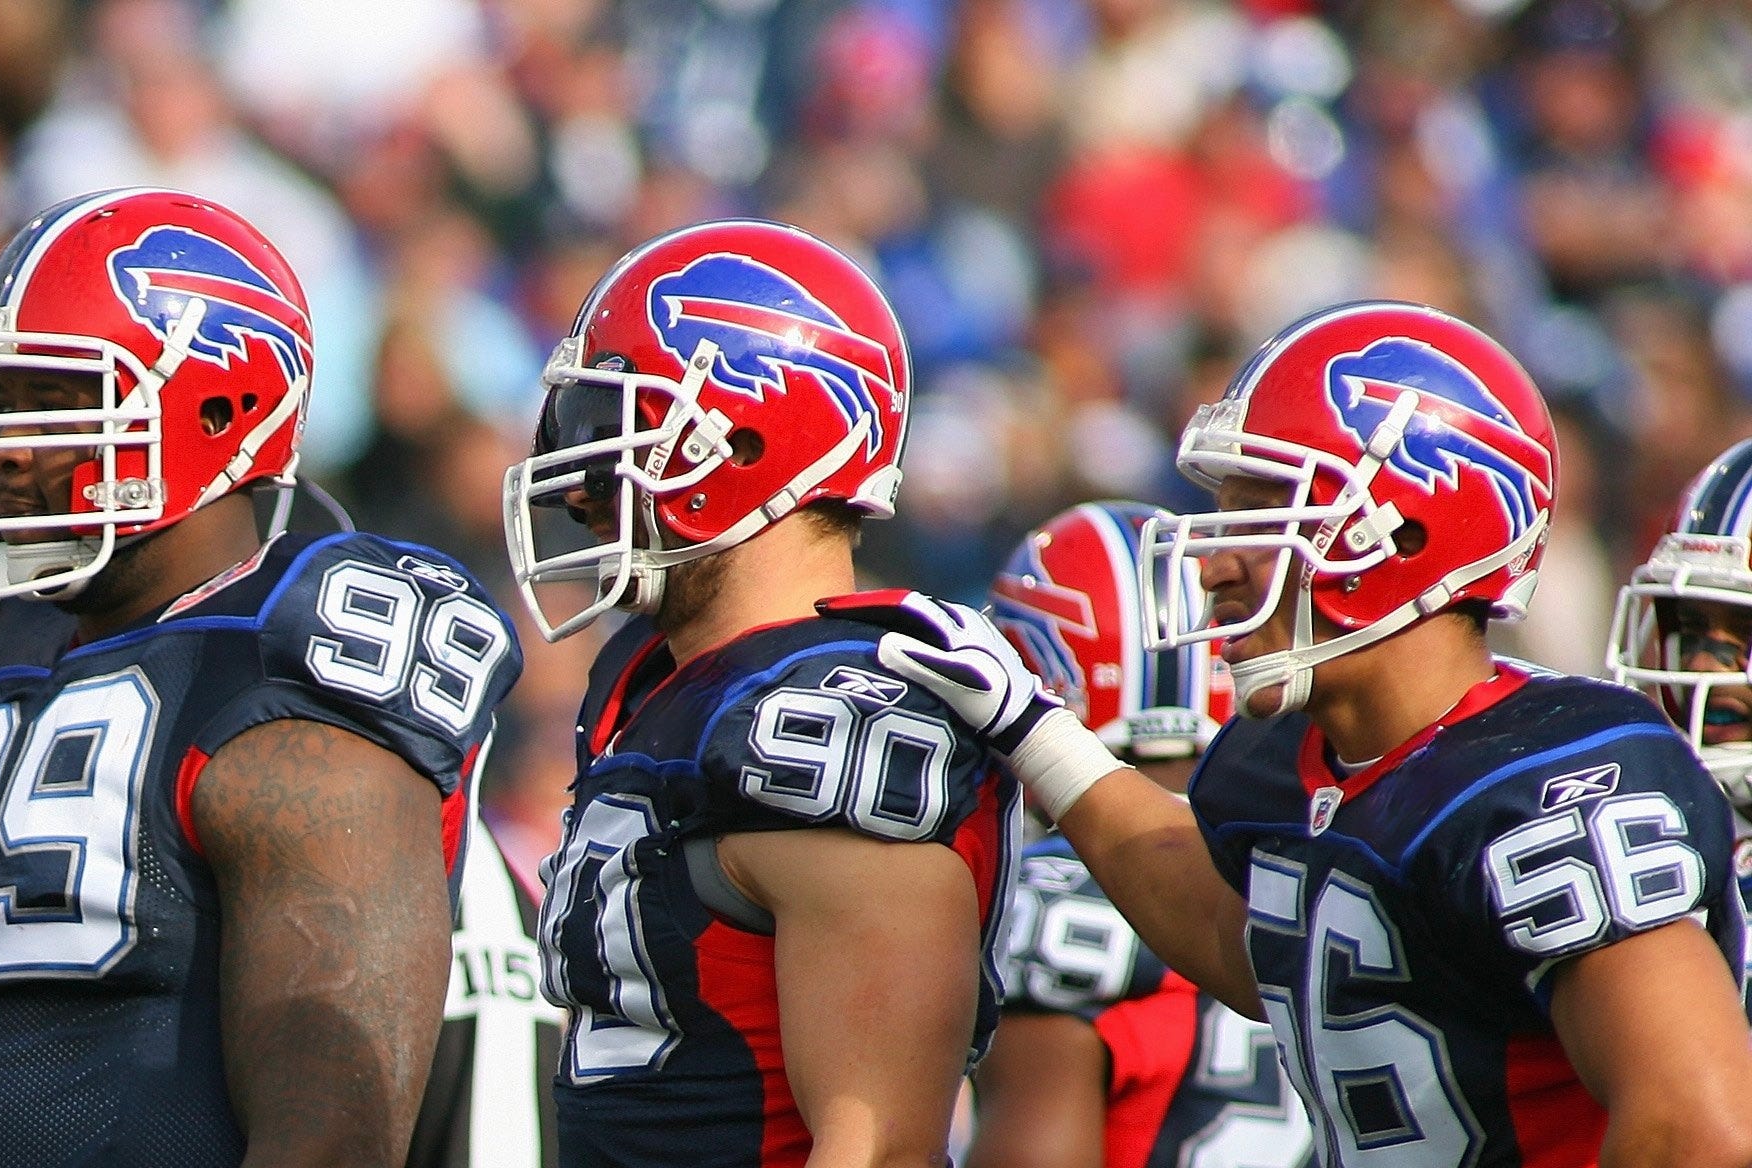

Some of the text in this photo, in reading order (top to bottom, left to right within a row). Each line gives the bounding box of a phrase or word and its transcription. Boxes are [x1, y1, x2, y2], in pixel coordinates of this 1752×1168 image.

[306, 559, 510, 736] 99
[739, 686, 957, 841] 90
[1485, 792, 1706, 957] 56
[454, 950, 536, 1002] 115
